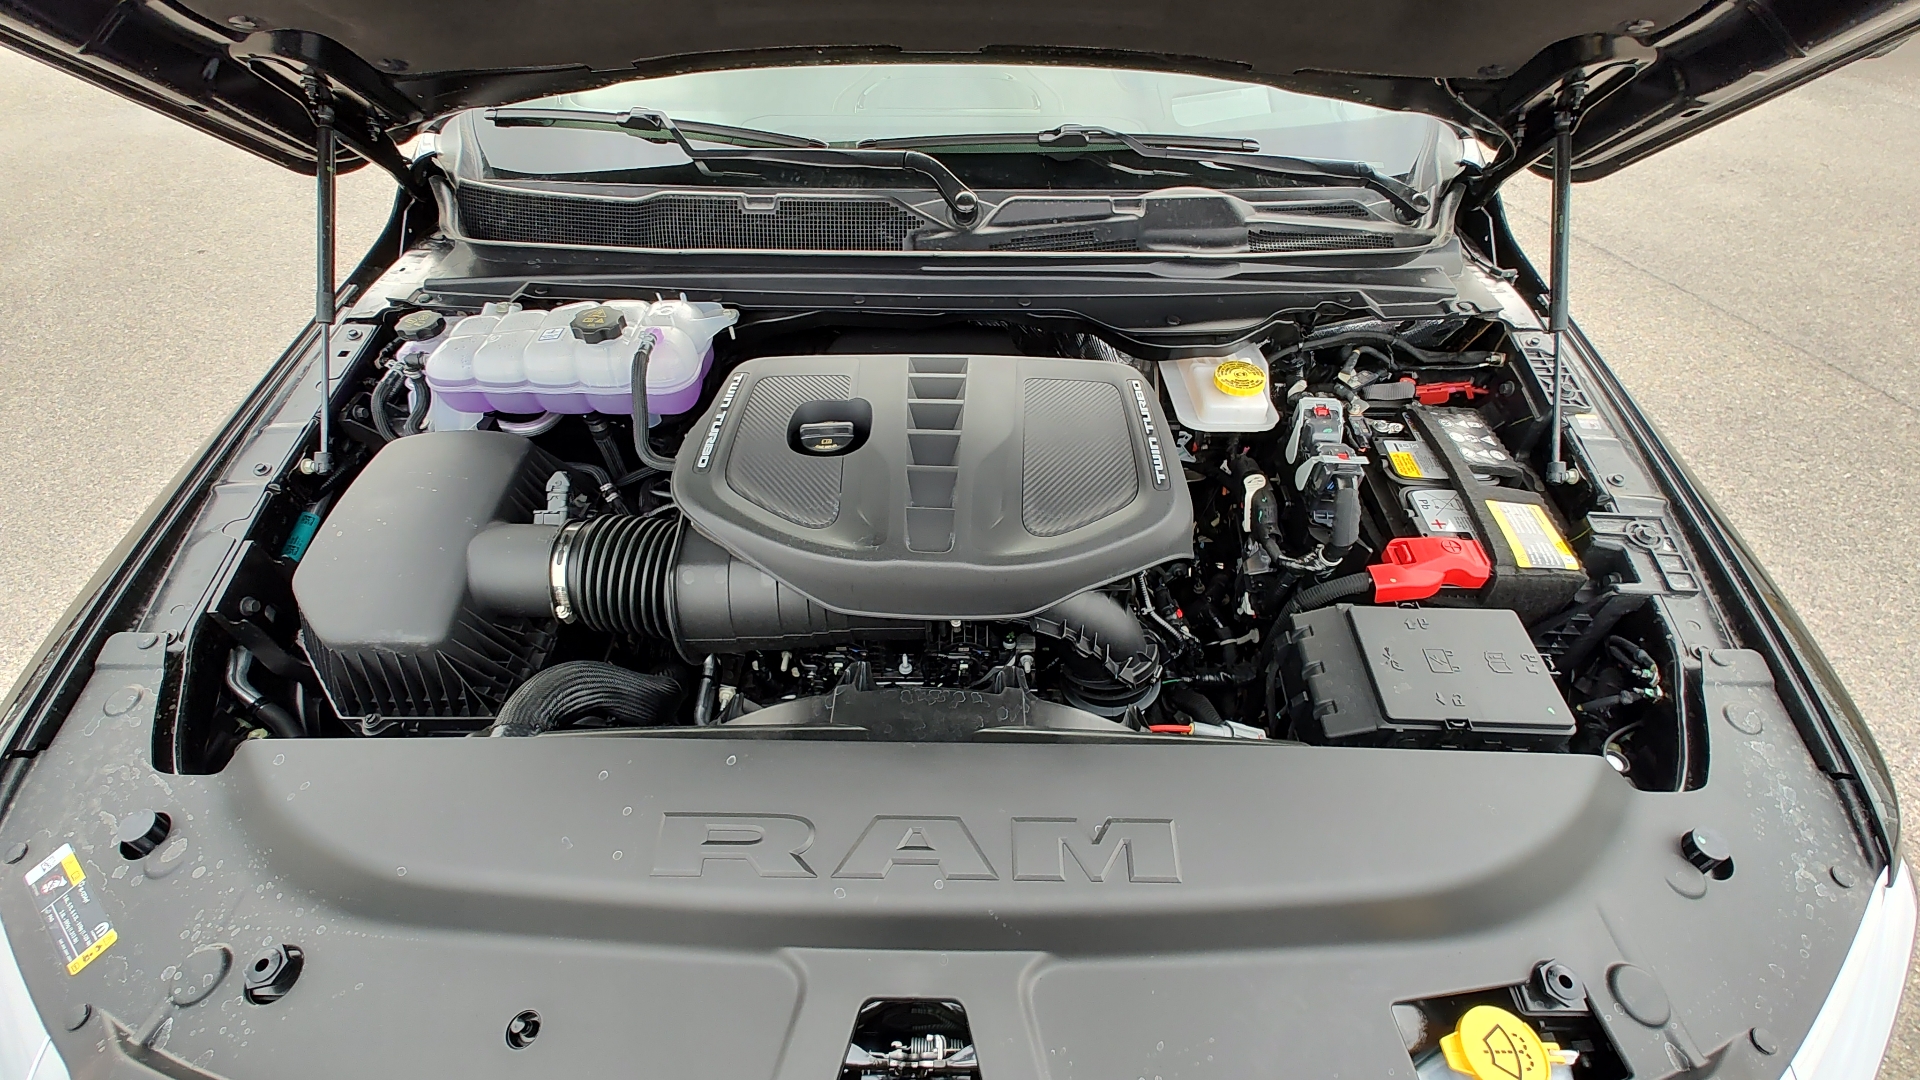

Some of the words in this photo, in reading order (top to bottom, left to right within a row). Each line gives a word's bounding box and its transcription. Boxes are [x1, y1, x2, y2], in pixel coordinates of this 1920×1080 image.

[720, 373, 744, 409] TWIN
[1131, 380, 1154, 434] TURBO
[697, 410, 728, 468] TURBO
[1148, 436, 1166, 485] TWIN
[1418, 499, 1430, 510] Pb
[650, 811, 1183, 884] RAM
